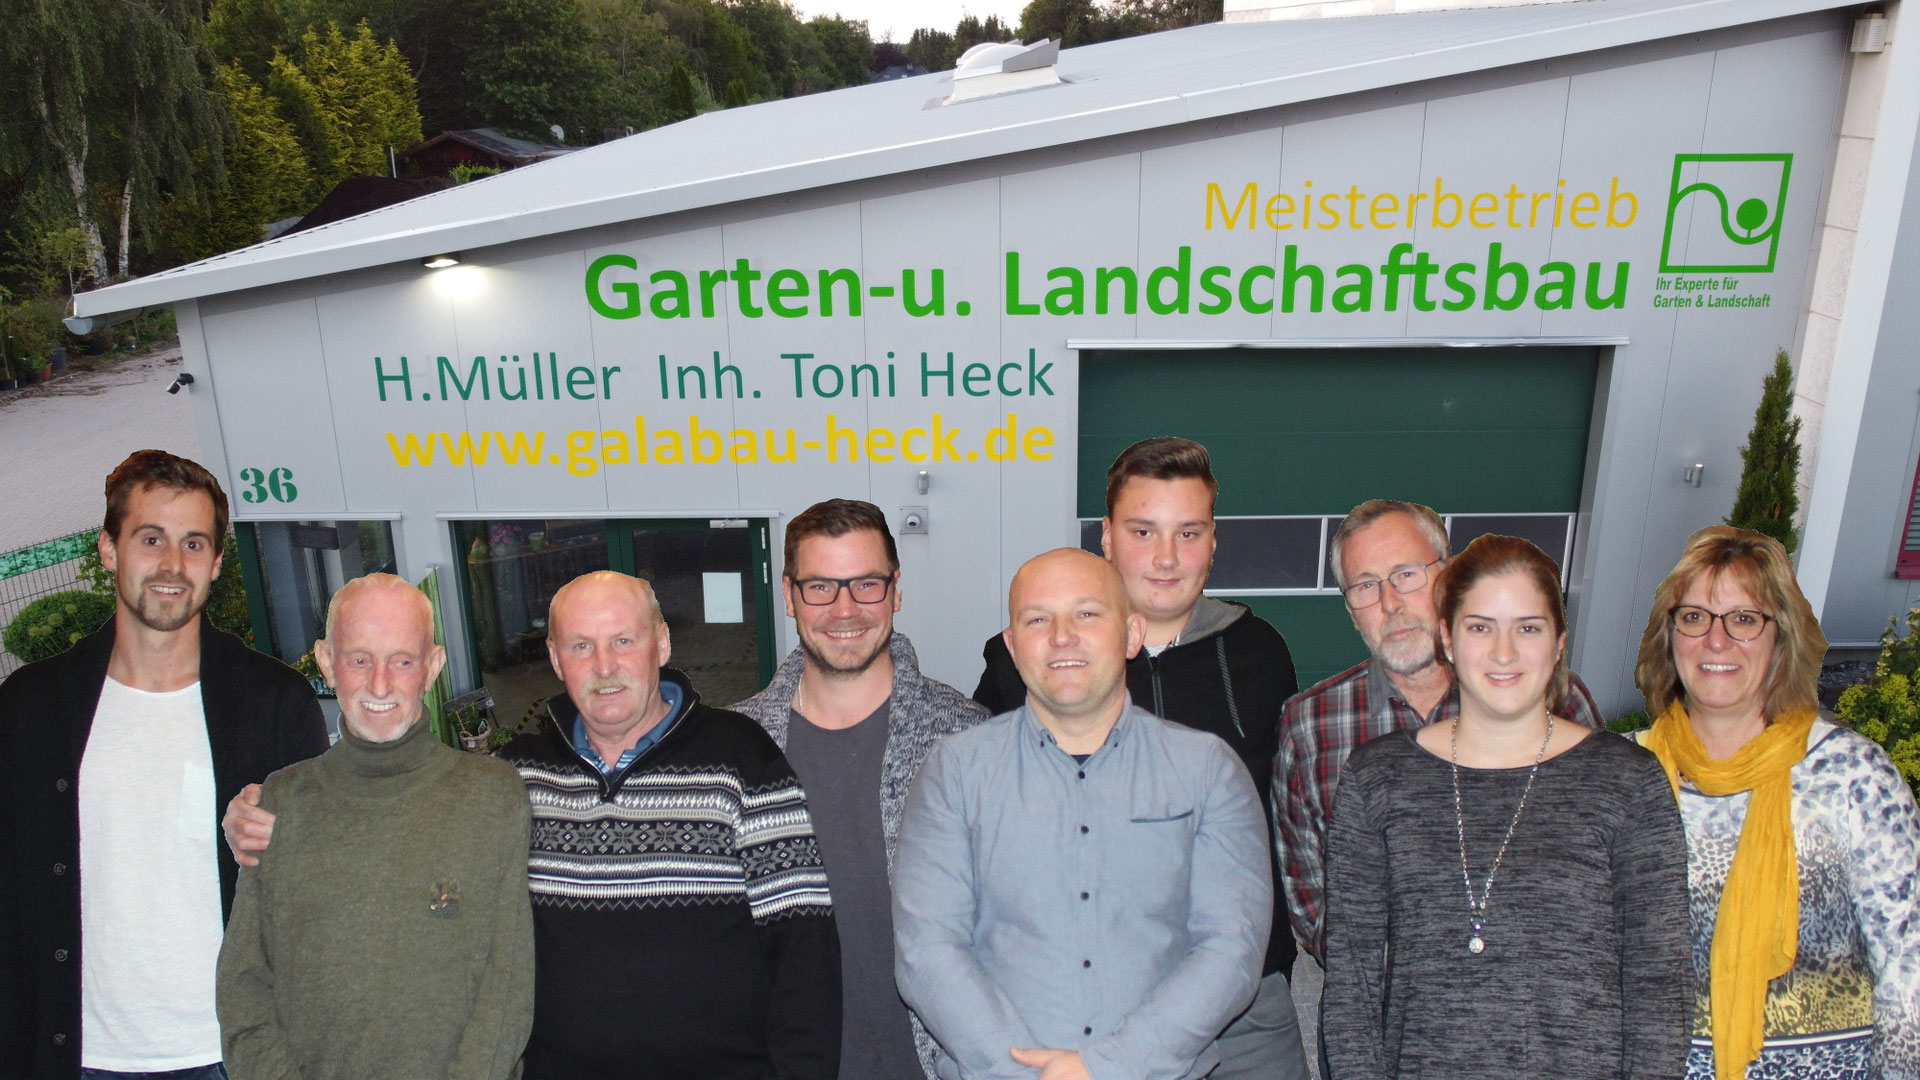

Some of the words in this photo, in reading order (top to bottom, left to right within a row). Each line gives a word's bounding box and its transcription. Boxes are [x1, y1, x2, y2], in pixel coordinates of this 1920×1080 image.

[1205, 176, 1639, 231] Meisterbetrieb
[585, 253, 971, 320] Garten-u.
[1005, 242, 1630, 316] Landschaftsbau
[1653, 294, 1692, 308] Garten
[1695, 294, 1704, 308] &
[1707, 294, 1771, 308] Landschaft
[1656, 277, 1672, 290] Ihr
[1674, 277, 1719, 293] Experte
[1722, 277, 1739, 291] für
[375, 351, 621, 402] H.Müller
[659, 350, 761, 399] Inh.
[780, 351, 896, 399] Toni
[920, 347, 1054, 397] Heck
[384, 412, 1055, 477] www.galabau-heck.de
[239, 467, 298, 504] 36
